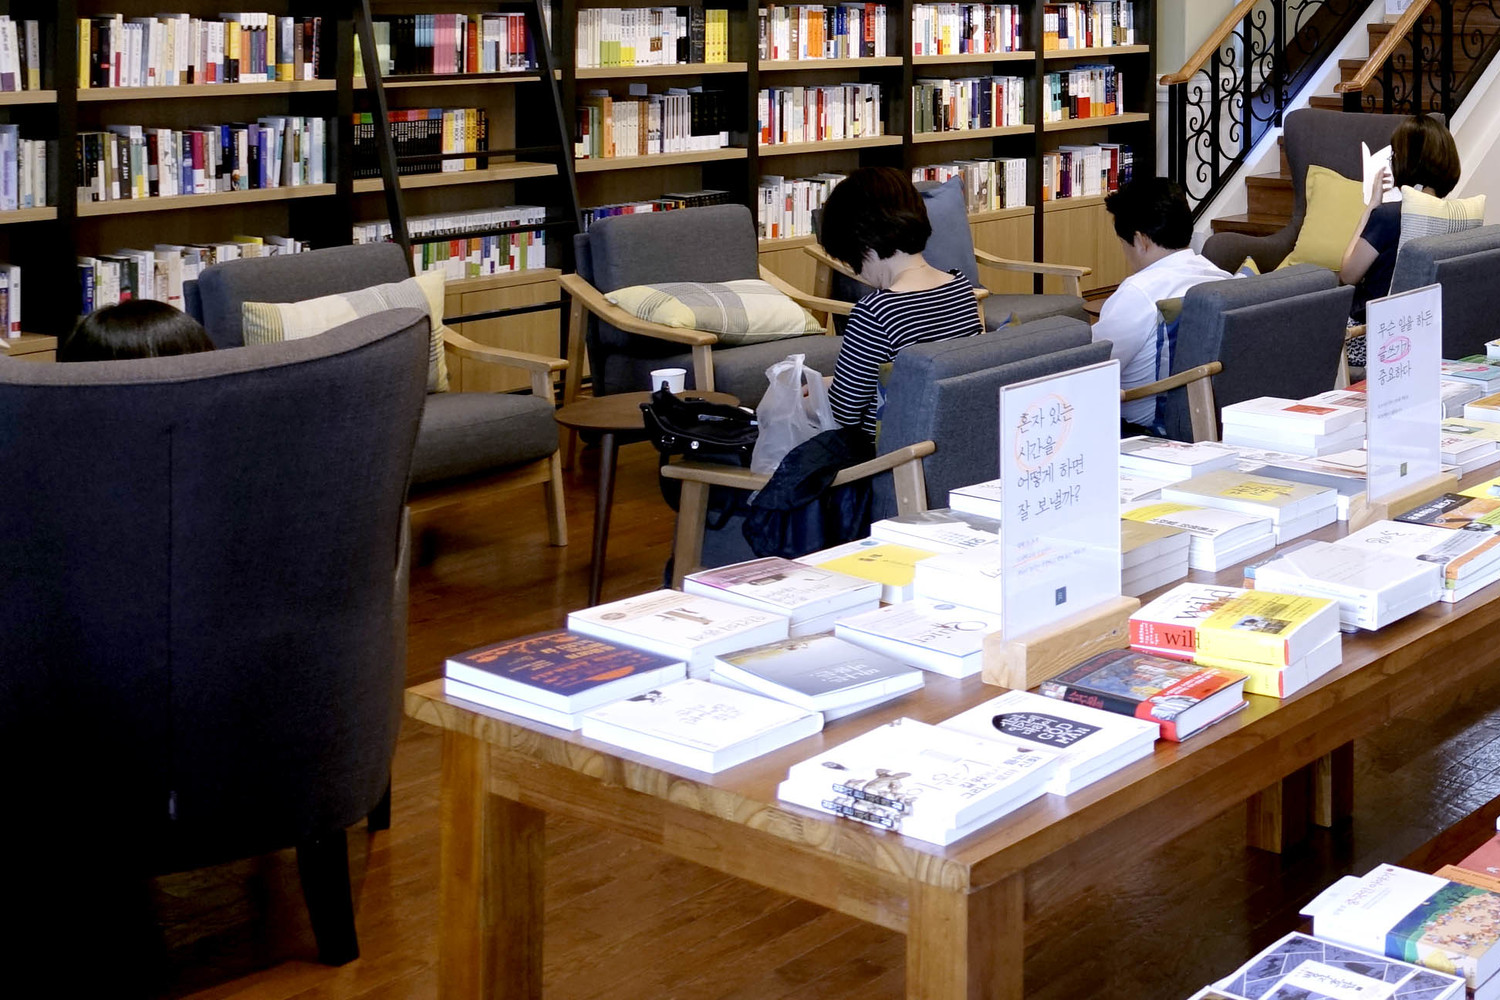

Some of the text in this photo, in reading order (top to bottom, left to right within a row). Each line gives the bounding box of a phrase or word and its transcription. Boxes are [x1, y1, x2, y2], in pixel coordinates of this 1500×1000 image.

[1378, 310, 1433, 338] 무슨 일을 하든
[1378, 360, 1411, 386] 중요하다
[1017, 402, 1075, 434] 혼자 있는
[1019, 436, 1056, 461] 시간을
[1017, 453, 1084, 491] 어떻게 하면
[1018, 485, 1081, 522] 잘 보낼까?
[1175, 588, 1236, 620] wild
[913, 620, 988, 643] Quiet
[1032, 721, 1078, 740] GOD
[1052, 726, 1094, 744] MAN
[898, 757, 993, 801] 이윤기
[957, 780, 997, 799] 그리스
[1013, 754, 1044, 768] 신화
